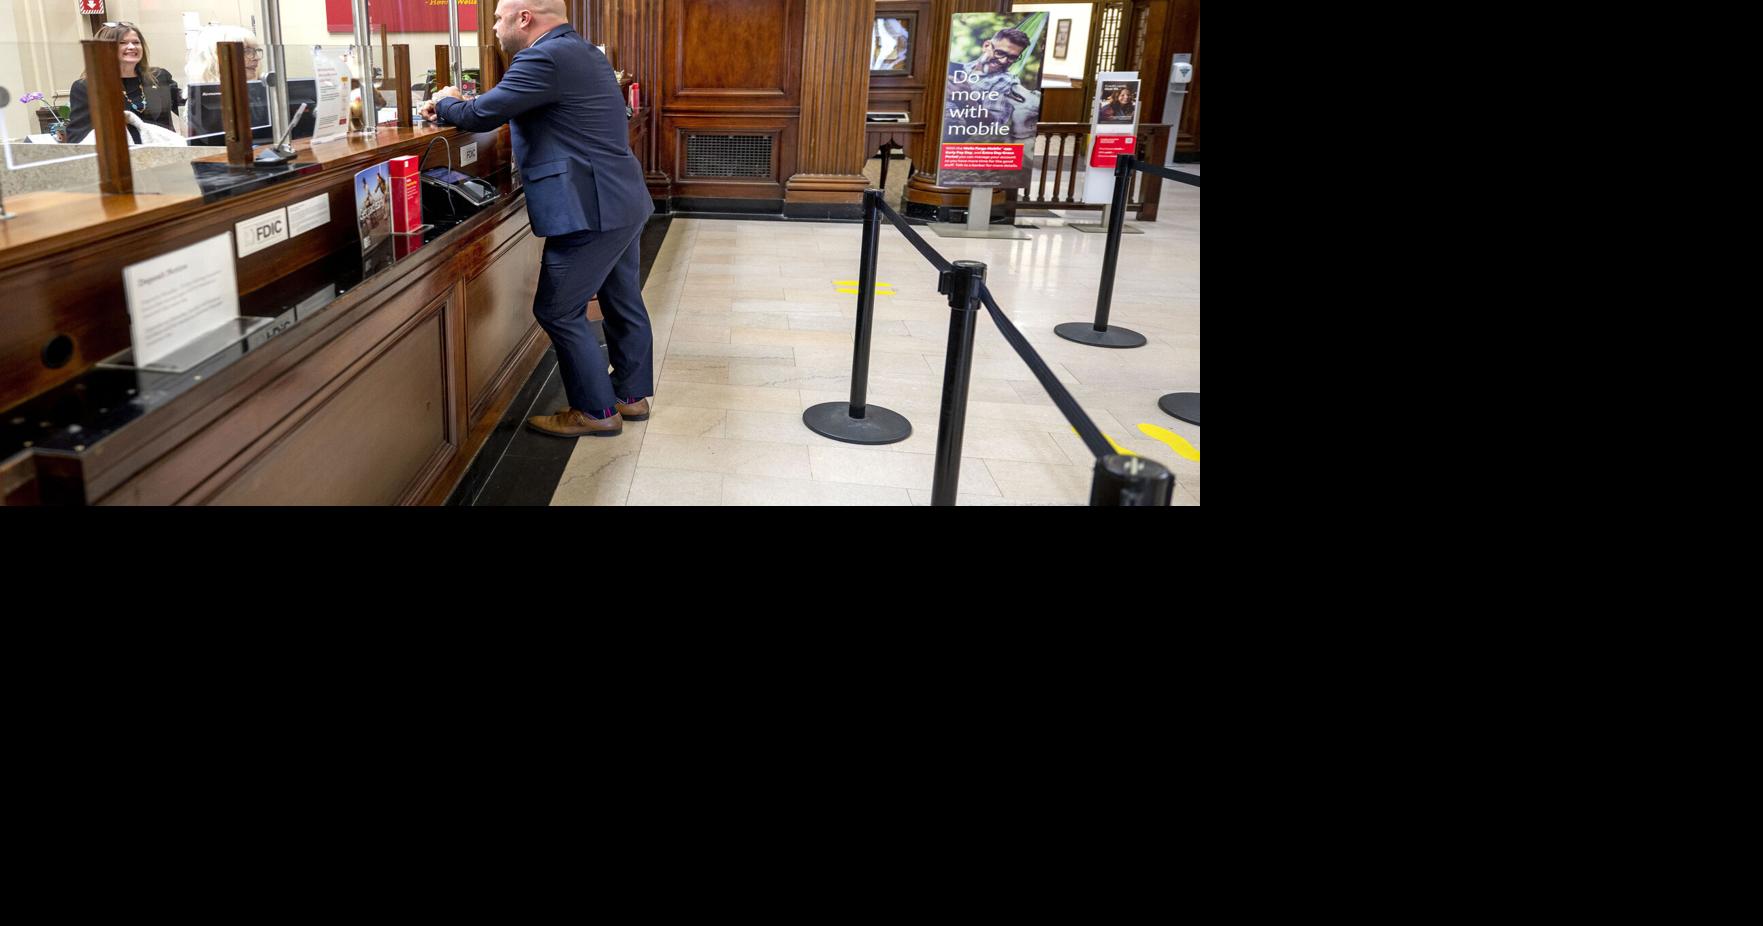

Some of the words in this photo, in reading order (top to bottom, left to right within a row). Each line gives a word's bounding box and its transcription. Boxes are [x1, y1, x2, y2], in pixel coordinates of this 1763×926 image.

[953, 70, 980, 84] Do
[951, 90, 999, 101] more
[949, 105, 988, 118] with
[948, 122, 1010, 135] mobile
[256, 220, 282, 240] FDIC
